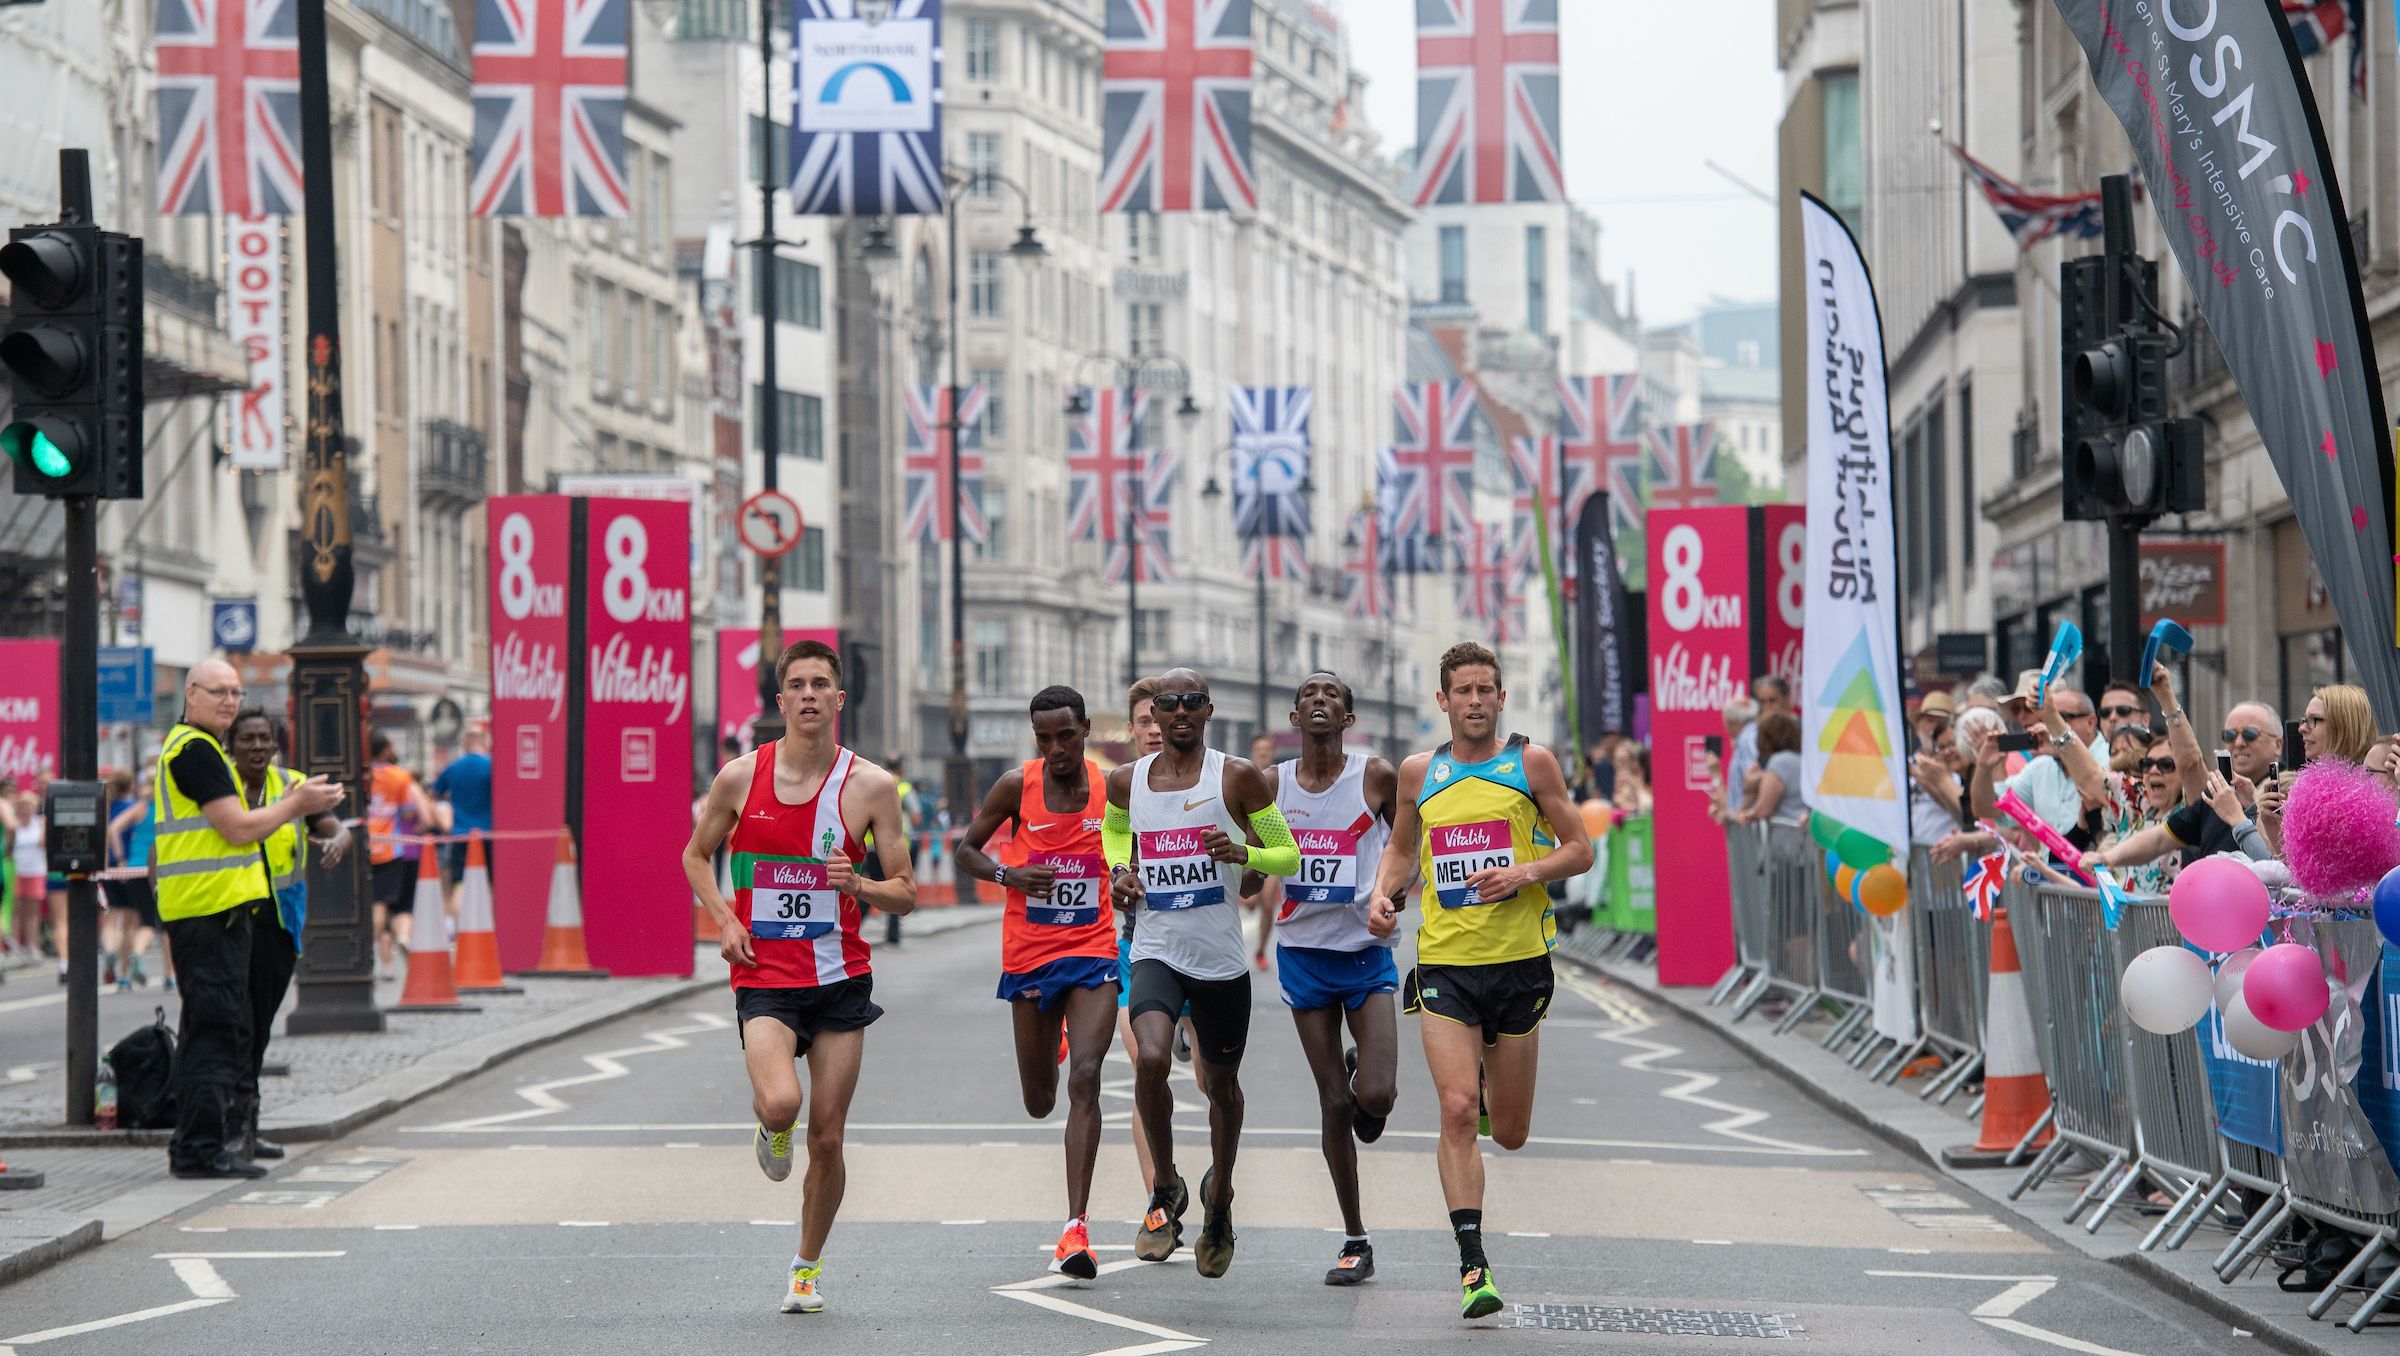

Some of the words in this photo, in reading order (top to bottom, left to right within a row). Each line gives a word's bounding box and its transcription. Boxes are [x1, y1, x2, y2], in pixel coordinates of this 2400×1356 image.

[2152, 31, 2165, 53] of
[2158, 55, 2171, 81] St
[2165, 80, 2203, 150] Mary's
[2198, 150, 2251, 245] Intensive
[239, 211, 270, 362] OOTS
[2249, 248, 2275, 300] Care
[2141, 556, 2213, 585] Pizza
[492, 630, 564, 722] Vitality
[590, 632, 687, 725] Vitality
[1155, 832, 1198, 855] Vitality
[1299, 832, 1339, 854] Vitality
[1445, 827, 1490, 850] Vitality
[774, 864, 817, 890] Vitality
[1046, 856, 1086, 878] Vitality
[1145, 860, 1217, 887] FARAH
[1300, 857, 1342, 884] 167
[777, 893, 811, 919] 36
